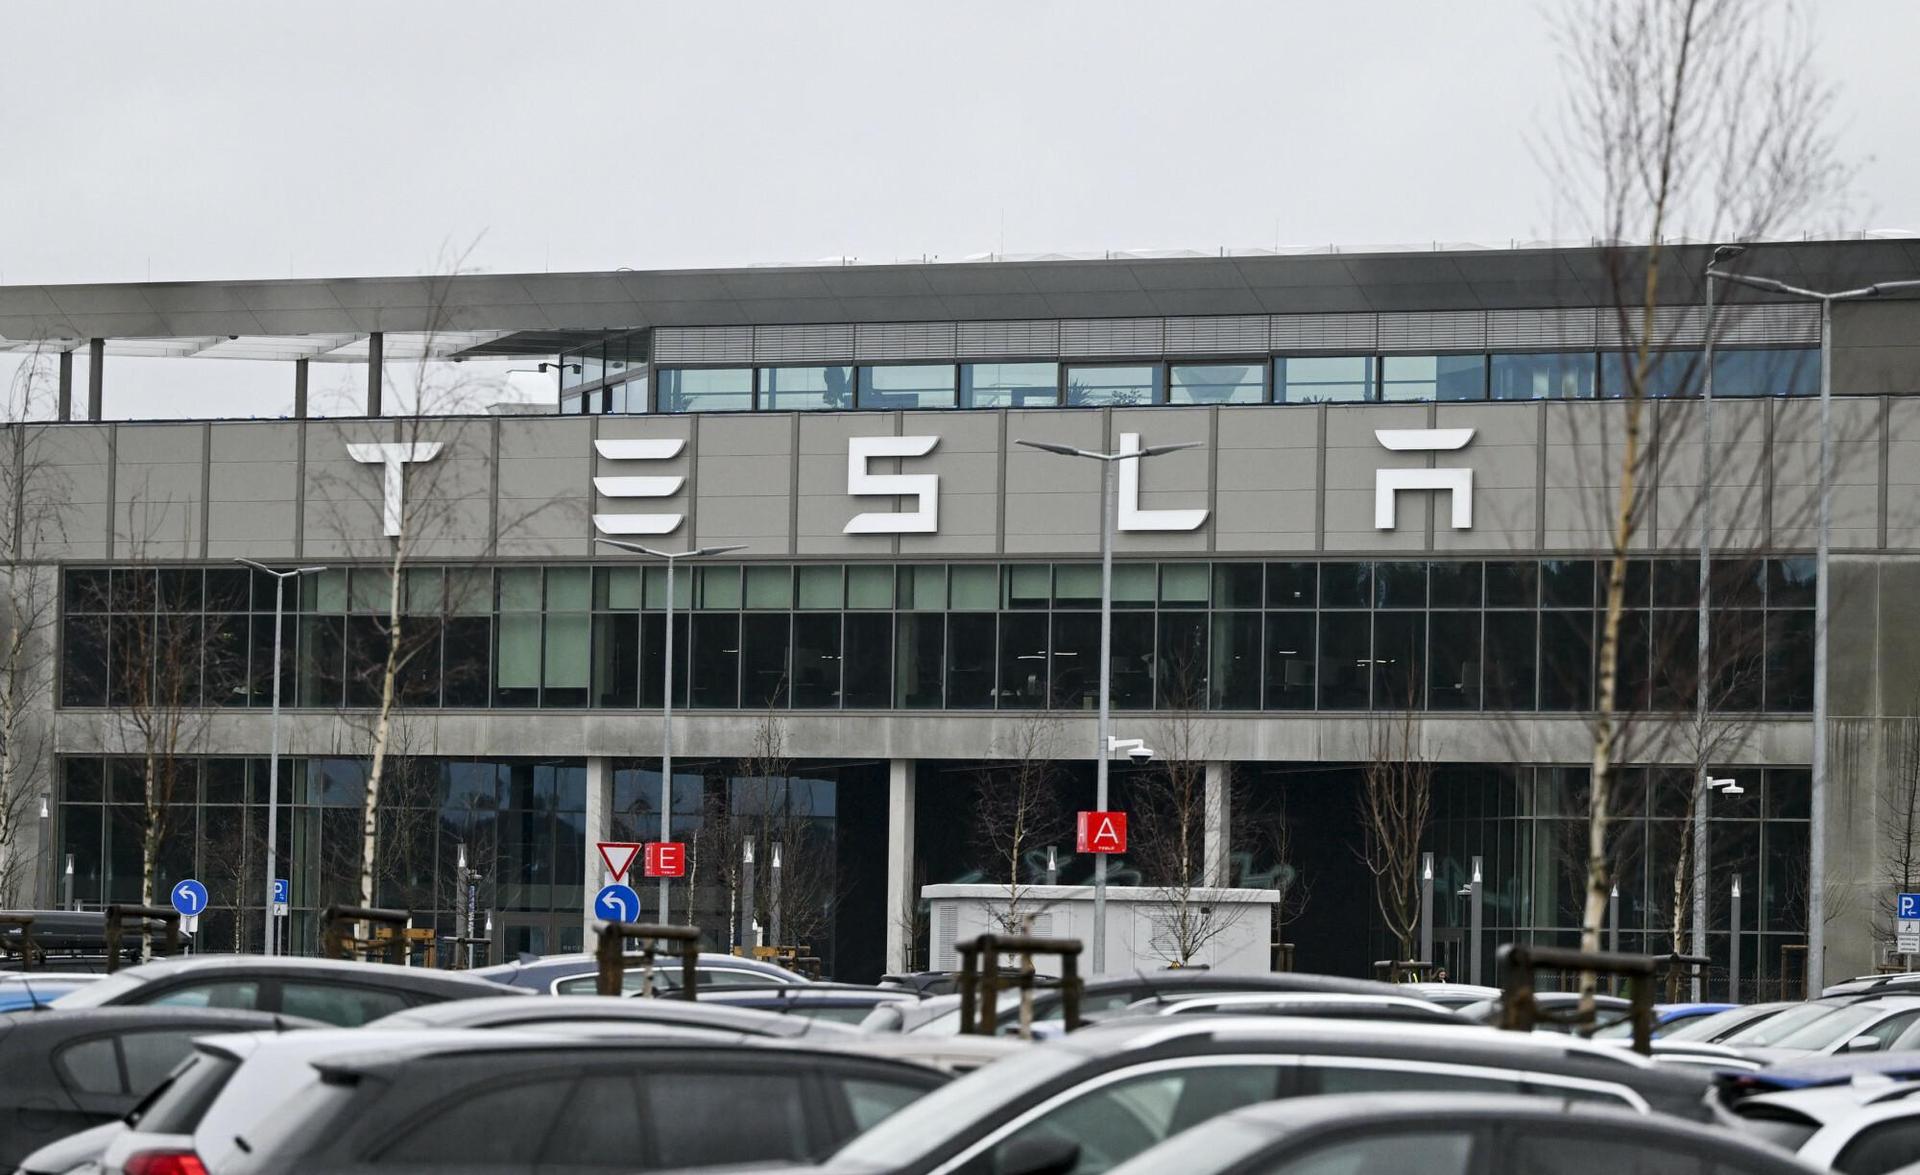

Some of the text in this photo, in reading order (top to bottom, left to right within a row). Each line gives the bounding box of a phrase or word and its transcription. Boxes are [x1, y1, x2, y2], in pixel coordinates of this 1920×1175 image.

[347, 428, 1476, 537] TESLA
[1093, 817, 1119, 844] A
[660, 847, 677, 869] E
[1901, 897, 1914, 916] P
